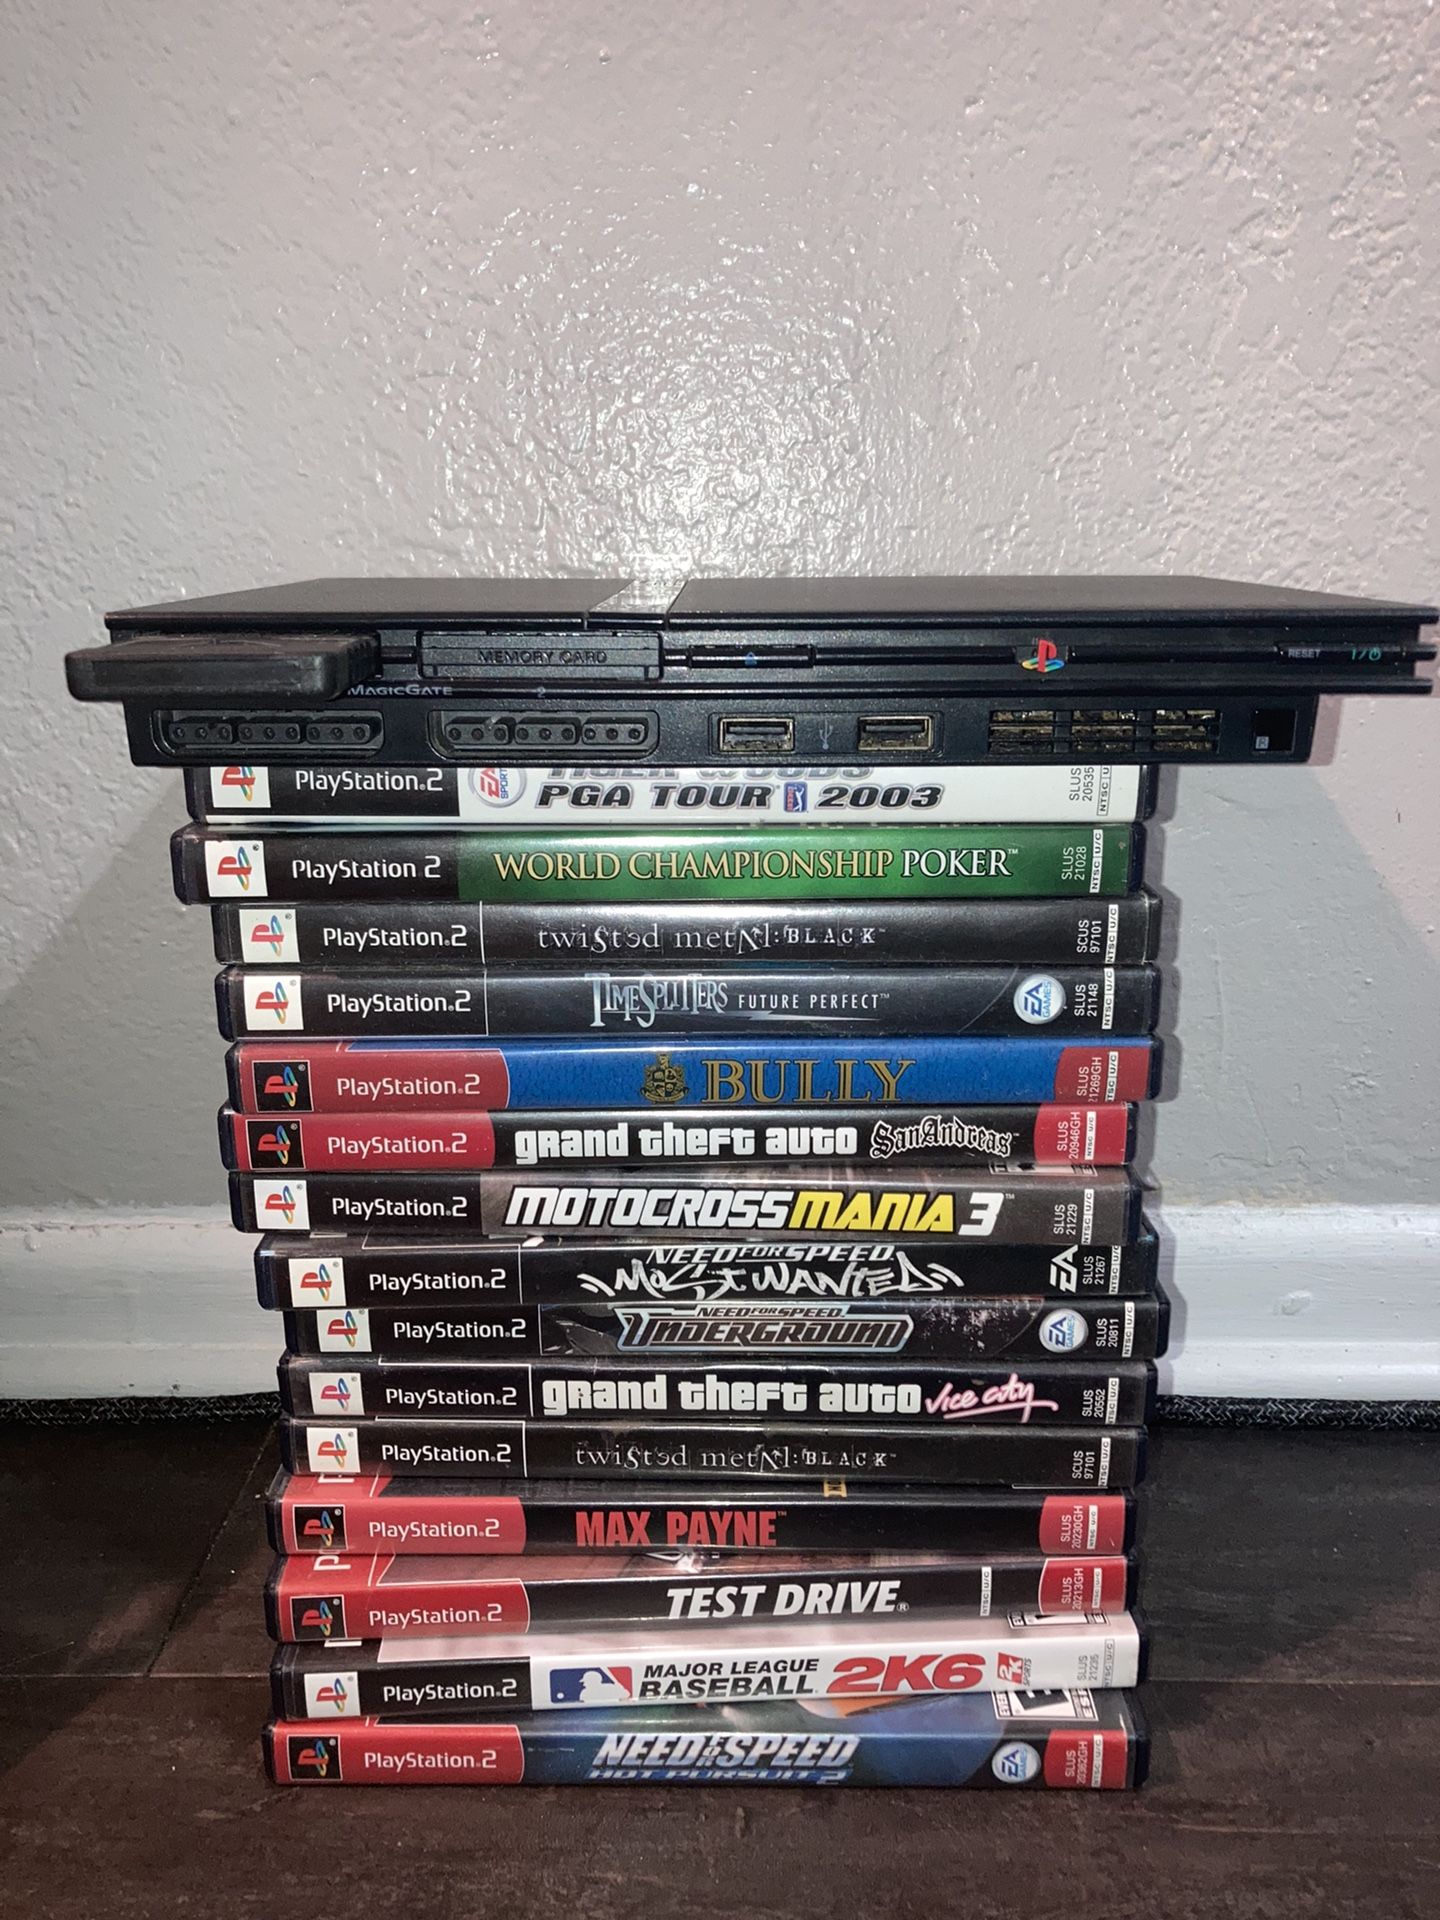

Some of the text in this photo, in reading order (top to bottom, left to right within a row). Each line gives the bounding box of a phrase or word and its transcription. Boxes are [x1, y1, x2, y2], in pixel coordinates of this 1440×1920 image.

[478, 649, 608, 665] MEMORY CARD
[1287, 647, 1321, 659] RESET
[536, 686, 547, 699] 2
[534, 782, 635, 810] PGA
[650, 782, 775, 810] TOUR
[815, 782, 945, 810] 2003
[1068, 767, 1082, 801] SLUS
[1082, 766, 1095, 802] 20535
[1099, 782, 1109, 812] NTSC
[291, 855, 442, 885] PlayStation 2
[493, 847, 1011, 882] WORLD CHAMPIONSHIP POKER
[1061, 847, 1074, 880] SLUS
[1074, 845, 1087, 880] 21028
[1091, 832, 1102, 890] NTSC U/C
[1076, 919, 1090, 953] SCUS
[1089, 920, 1102, 953] 97101
[1106, 907, 1117, 963] NTSC U/C
[738, 993, 799, 1010] FUTURE
[809, 992, 880, 1010] PERFECT
[1023, 982, 1043, 1017] EA
[1042, 980, 1052, 1018] GAMES
[1074, 984, 1087, 1017] SLUS
[1086, 983, 1099, 1017] 21148
[1104, 970, 1113, 1027] NTSC U/C
[702, 1059, 915, 1104] BULLY
[1076, 1066, 1090, 1097] SLUS
[1106, 1054, 1117, 1101] TSC U/C
[1057, 1121, 1069, 1152] SLUS
[1069, 1111, 1081, 1160] 20946GH
[957, 1191, 1005, 1236] 3
[1053, 1204, 1066, 1235] SLUS
[1065, 1203, 1078, 1236] 21229
[1083, 1191, 1093, 1244] NTSC U/C
[1049, 1244, 1079, 1294] EA
[1082, 1255, 1094, 1285] SLUS
[1094, 1255, 1106, 1286] 21267
[1110, 1268, 1119, 1293] NTSC
[696, 1306, 752, 1318] NEED
[1048, 1316, 1067, 1348] EA
[1096, 1318, 1108, 1348] SLUS
[1108, 1318, 1119, 1348] 20811
[1124, 1331, 1133, 1355] NTSC
[1082, 1389, 1094, 1417] SLUS
[1094, 1388, 1106, 1418] 20552
[1110, 1380, 1118, 1398] U/C
[1072, 1450, 1084, 1479] SCUS
[1084, 1451, 1095, 1479] 97101
[576, 1511, 778, 1547] MAX PAYNE
[1060, 1514, 1073, 1543] SLUS
[1072, 1505, 1084, 1549] 20230GH
[666, 1580, 901, 1620] TEST DRIVE
[1061, 1577, 1073, 1604] SLUS
[1072, 1568, 1085, 1610] 20213GH
[644, 1659, 819, 1678] MAJOR LEAGUE
[826, 1653, 985, 1694] 2K6
[999, 1656, 1023, 1681] 2K
[1022, 1657, 1032, 1687] SPORTS
[1077, 1655, 1089, 1682] SLUS
[639, 1674, 818, 1700] BASEBALL
[592, 1733, 708, 1767] NEED
[1001, 1749, 1019, 1777] EA
[1065, 1750, 1077, 1777] SLUS
